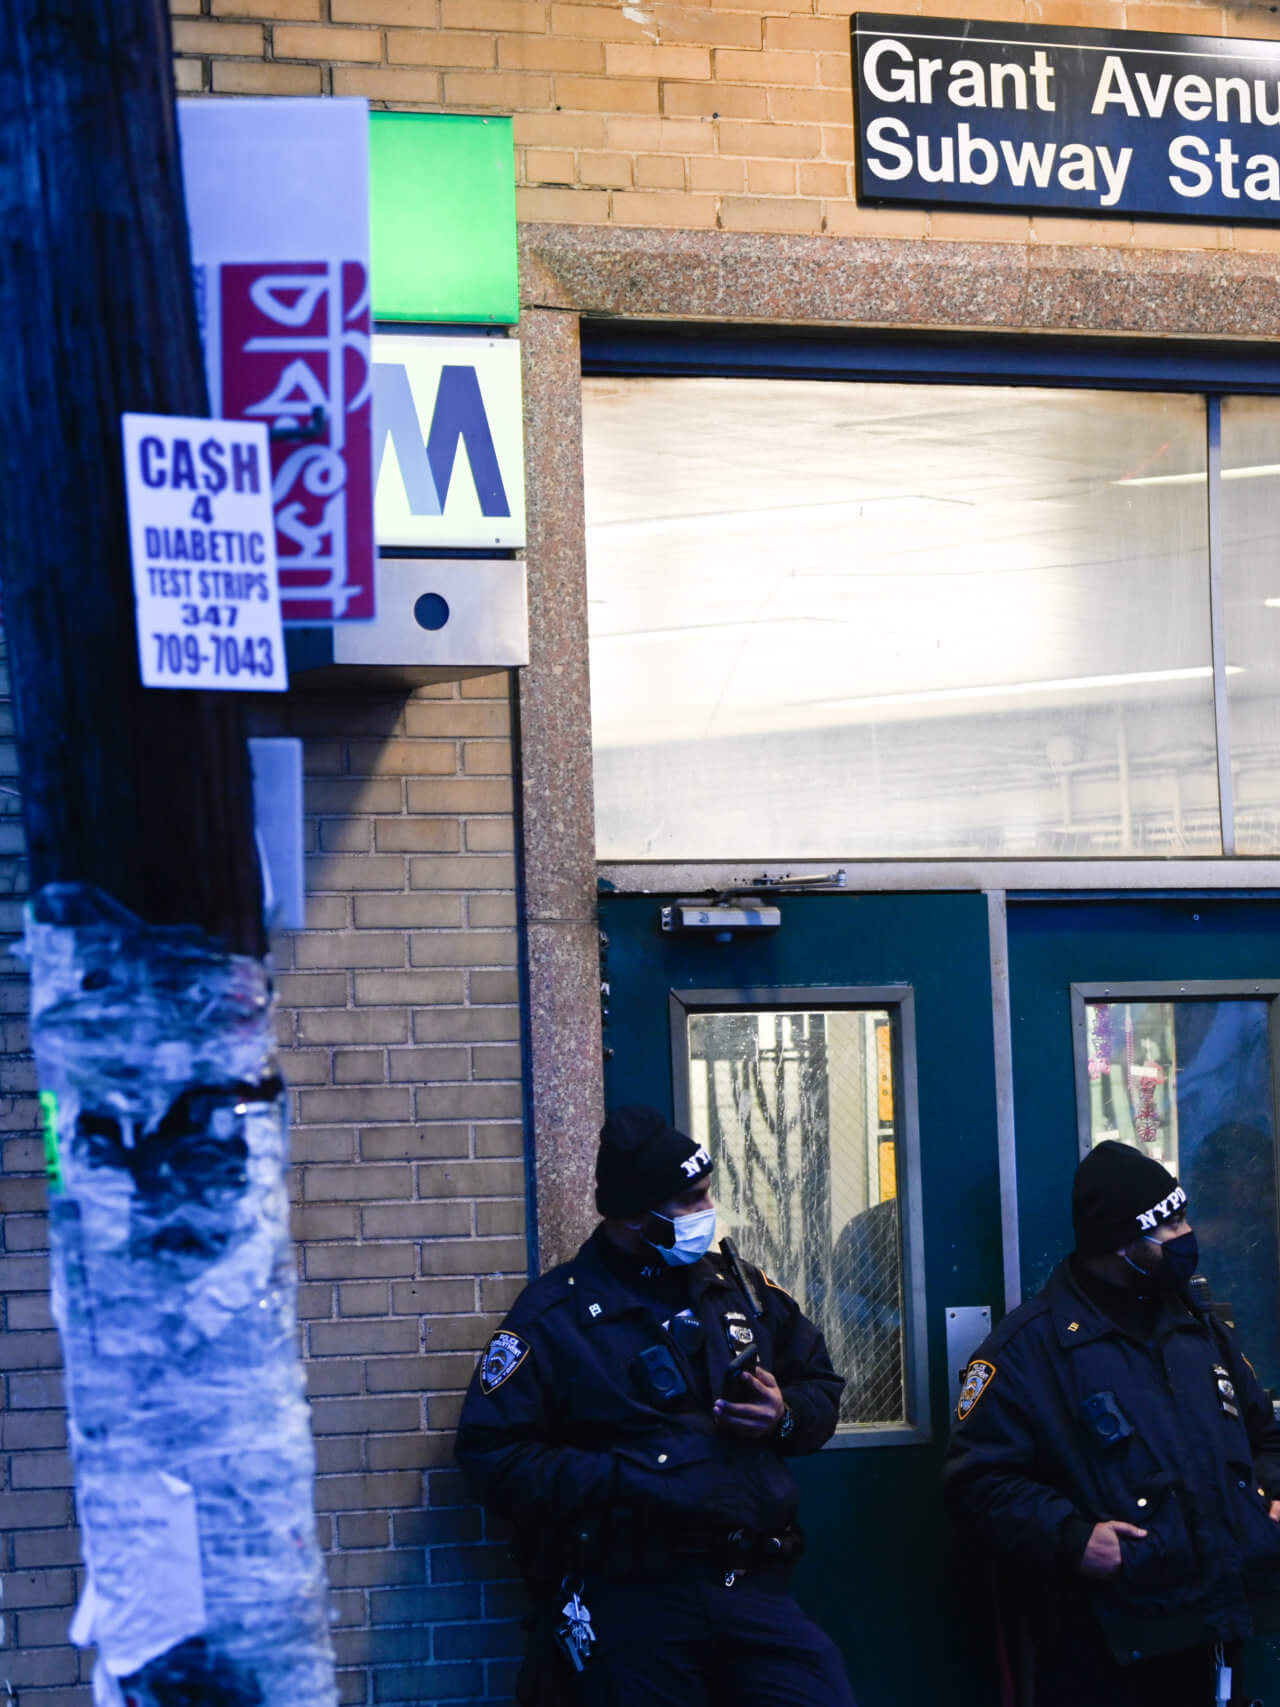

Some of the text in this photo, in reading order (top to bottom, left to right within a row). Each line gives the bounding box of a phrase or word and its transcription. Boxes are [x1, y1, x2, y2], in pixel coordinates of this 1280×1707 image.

[863, 39, 1057, 112] Grant
[865, 116, 1134, 207] Subway
[139, 435, 261, 496] CA$H
[190, 493, 214, 525] 4
[144, 526, 265, 566] DIABETIC
[146, 566, 270, 602] TEST STRIPS
[180, 602, 238, 628] 347
[152, 632, 275, 678] 709-7043
